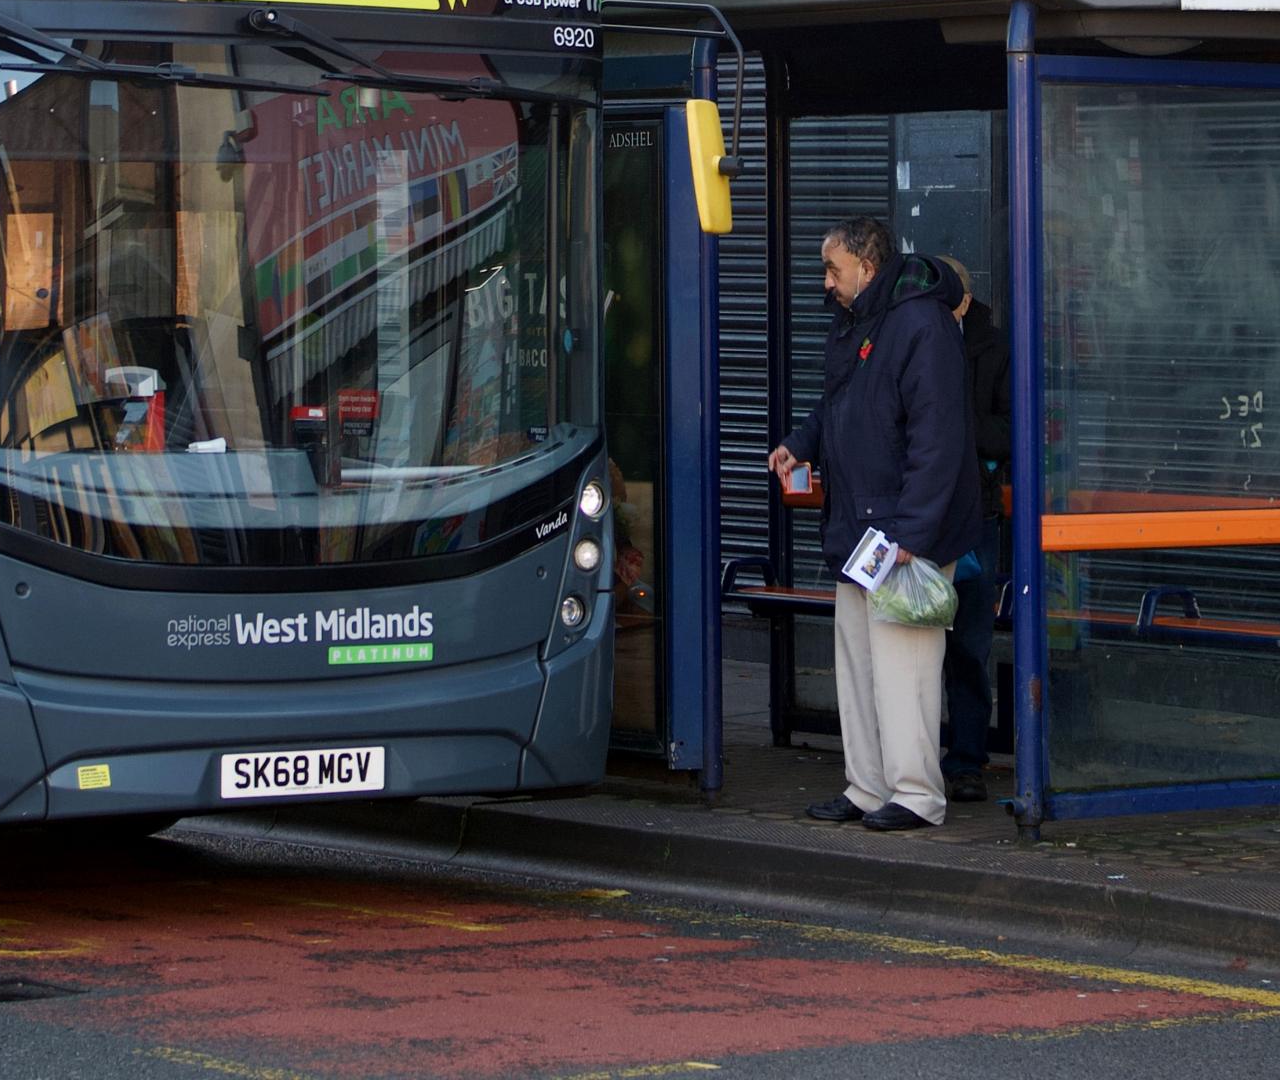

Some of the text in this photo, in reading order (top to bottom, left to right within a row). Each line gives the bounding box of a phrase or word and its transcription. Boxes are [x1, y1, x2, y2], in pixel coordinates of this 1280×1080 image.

[553, 26, 595, 48] 6920
[608, 131, 654, 148] ADSHEL
[535, 511, 568, 539] Vanda
[167, 605, 434, 645] national West Midlands
[167, 632, 231, 650] express
[332, 646, 429, 661] PLATINUM
[234, 751, 371, 790] SK68 MGV
